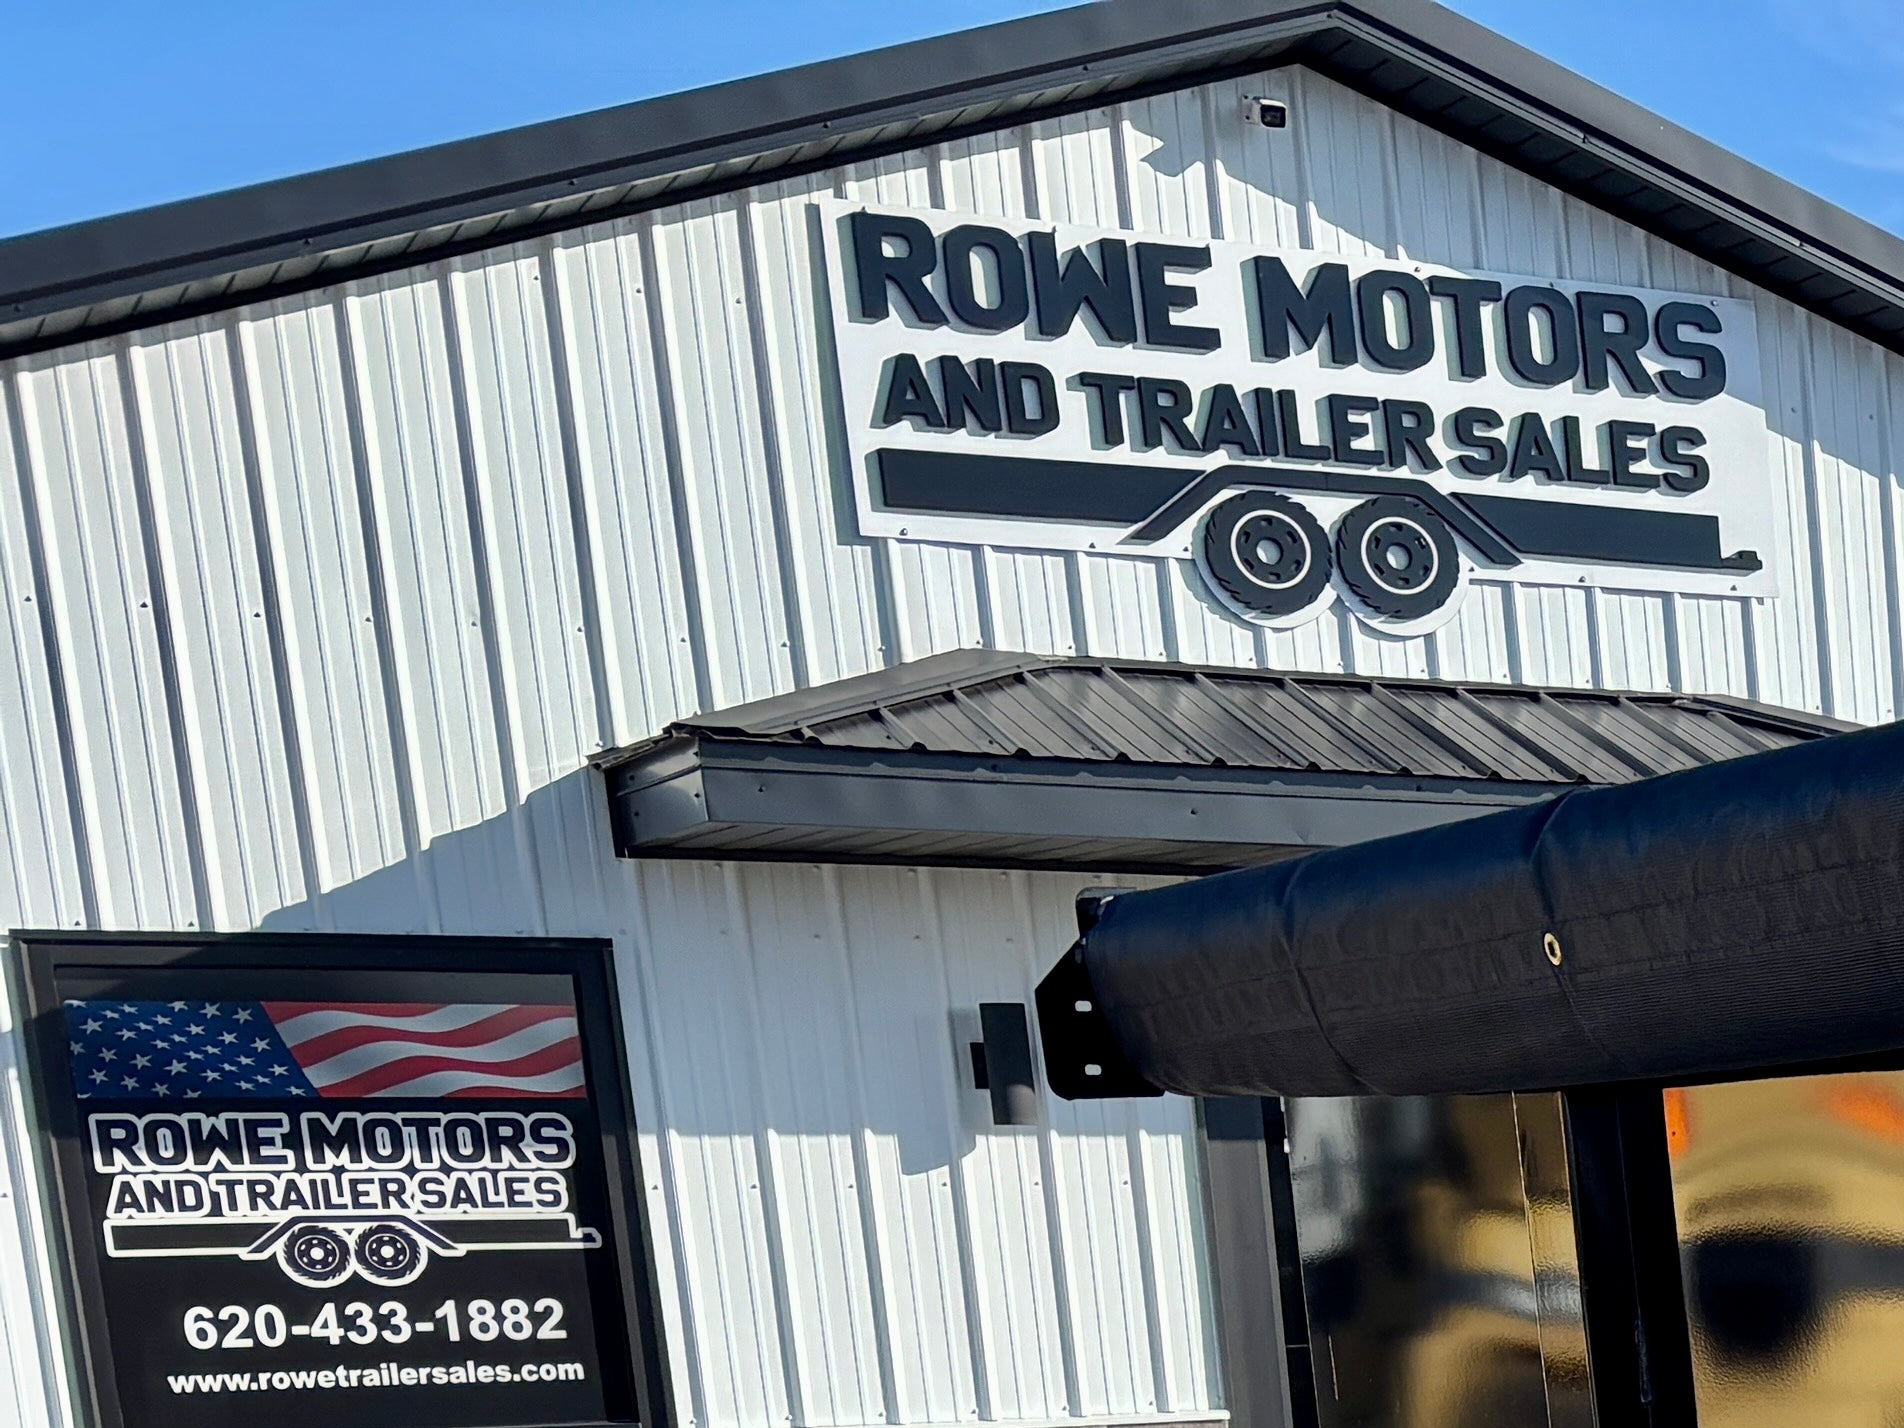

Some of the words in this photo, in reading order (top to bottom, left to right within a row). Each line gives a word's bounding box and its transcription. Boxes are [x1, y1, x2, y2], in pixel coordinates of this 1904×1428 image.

[848, 208, 1222, 354] ROWE
[1242, 254, 1728, 402] MOTORS
[870, 351, 1061, 437] AND
[1066, 369, 1443, 475] TRAILER
[1444, 405, 1711, 493] SALES
[88, 1112, 294, 1174] ROWE
[300, 1112, 576, 1172] MOTORS
[107, 1174, 212, 1218] AND
[211, 1173, 414, 1216] TRAILER
[411, 1170, 569, 1213] SALES
[183, 1298, 568, 1350] 620-433-1882
[167, 1359, 586, 1395] www.rowetrailersales.com
